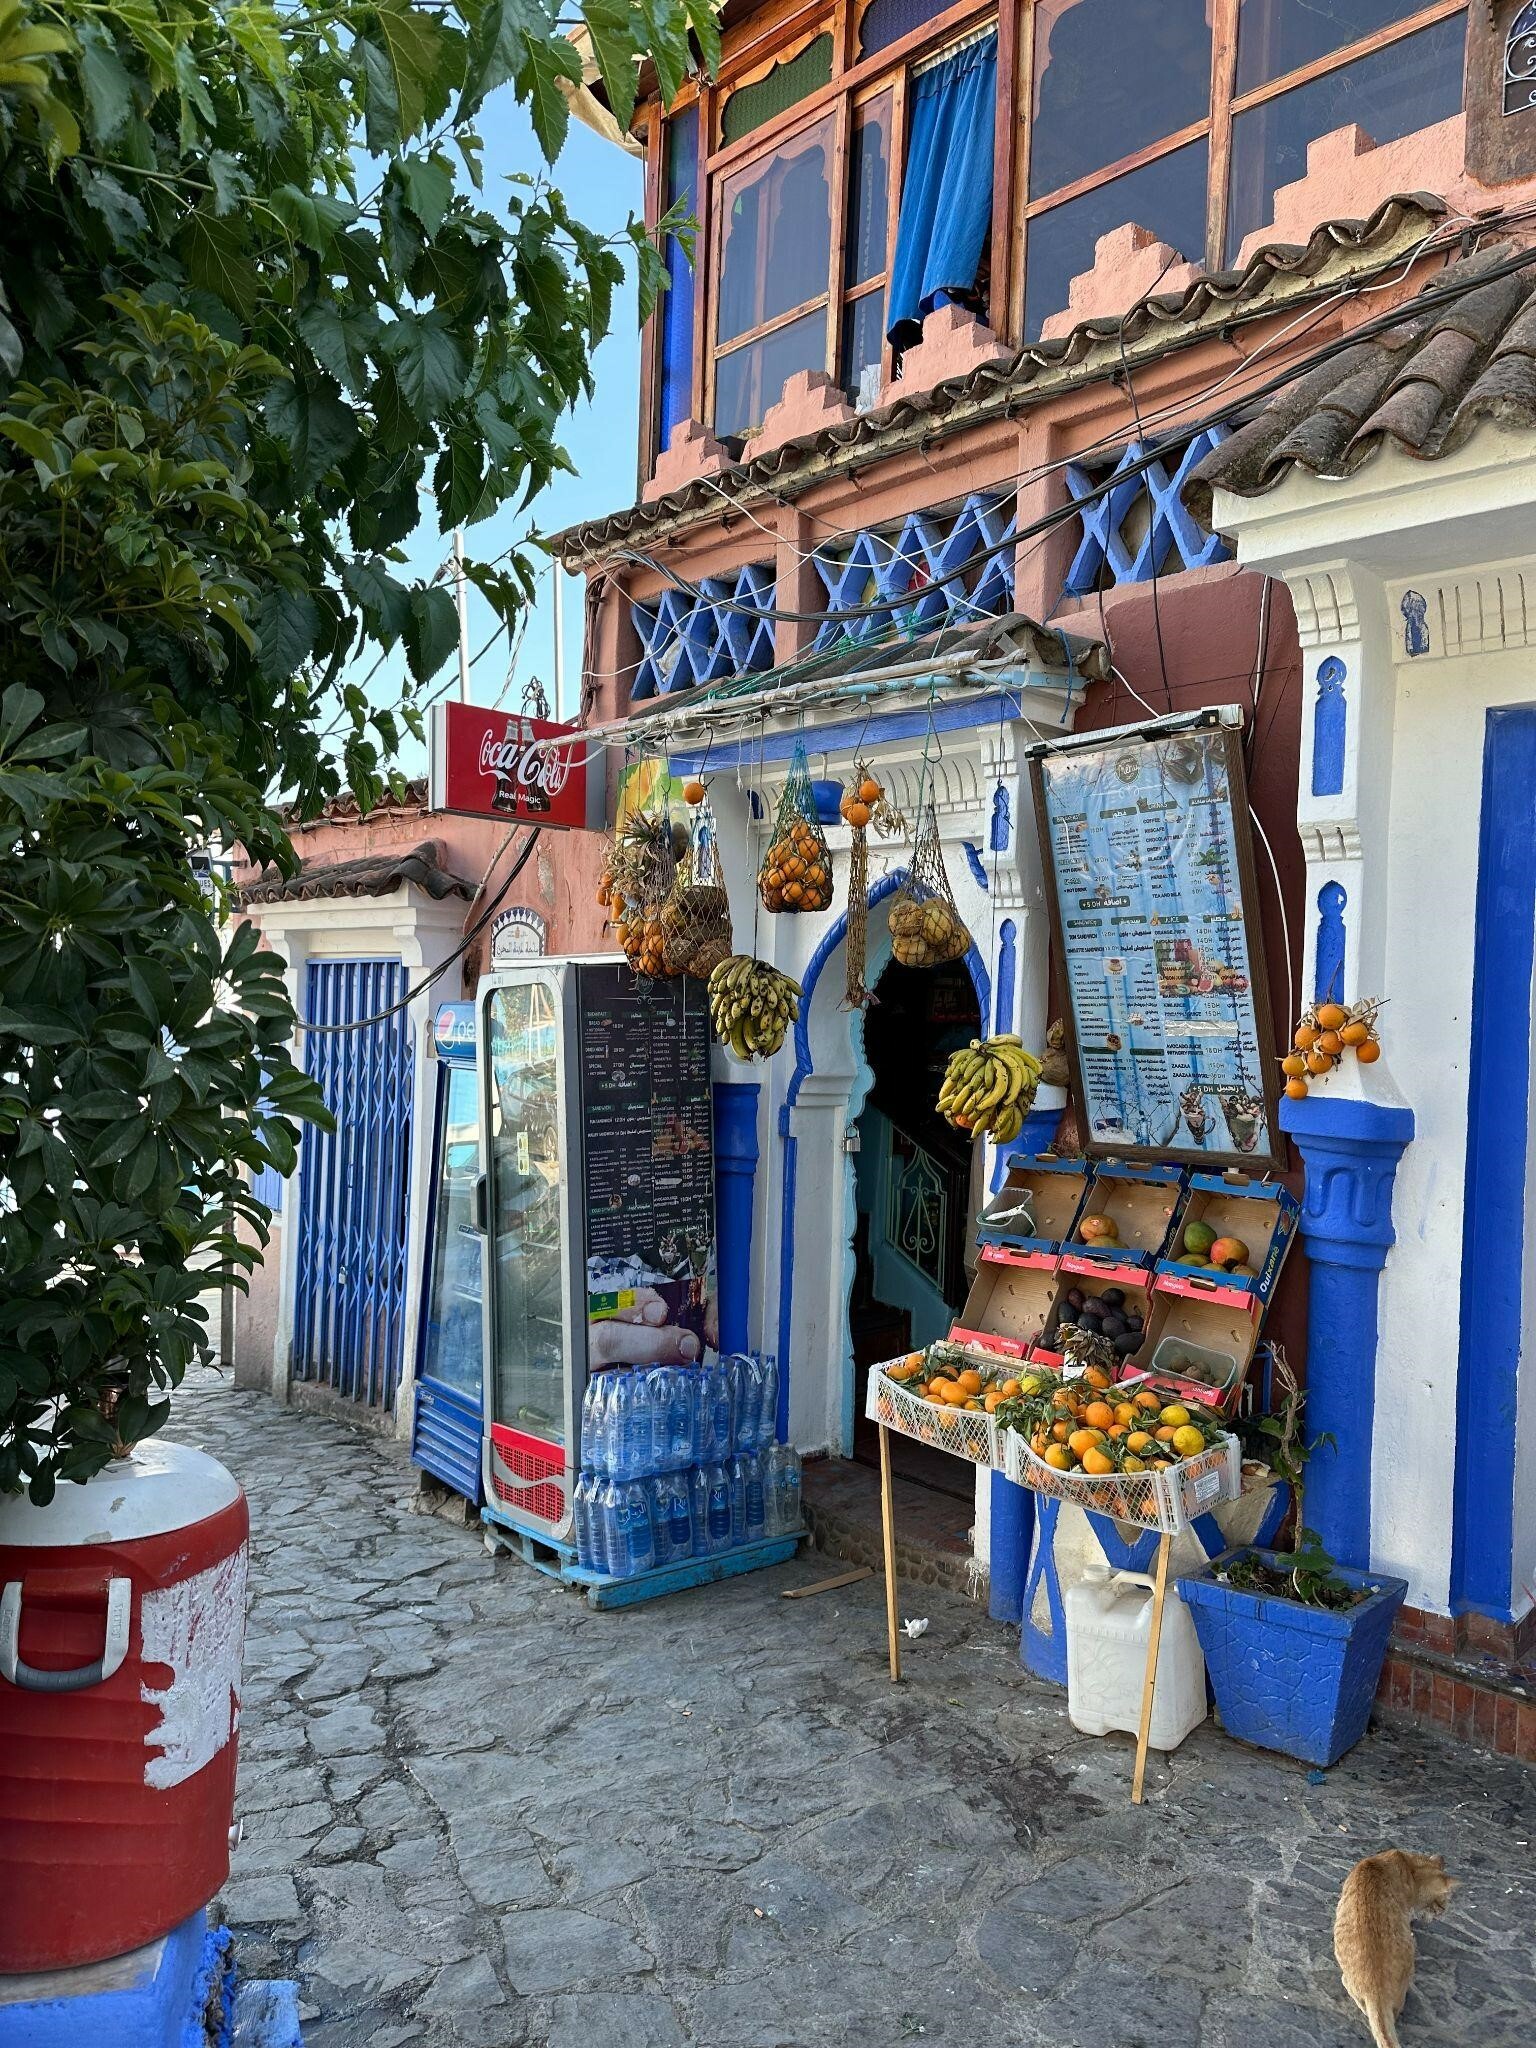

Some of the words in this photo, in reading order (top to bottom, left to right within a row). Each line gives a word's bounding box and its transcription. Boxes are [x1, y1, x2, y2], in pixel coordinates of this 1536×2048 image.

[479, 729, 560, 788] Coca-Cola
[499, 790, 516, 799] Real
[518, 794, 541, 804] Magic
